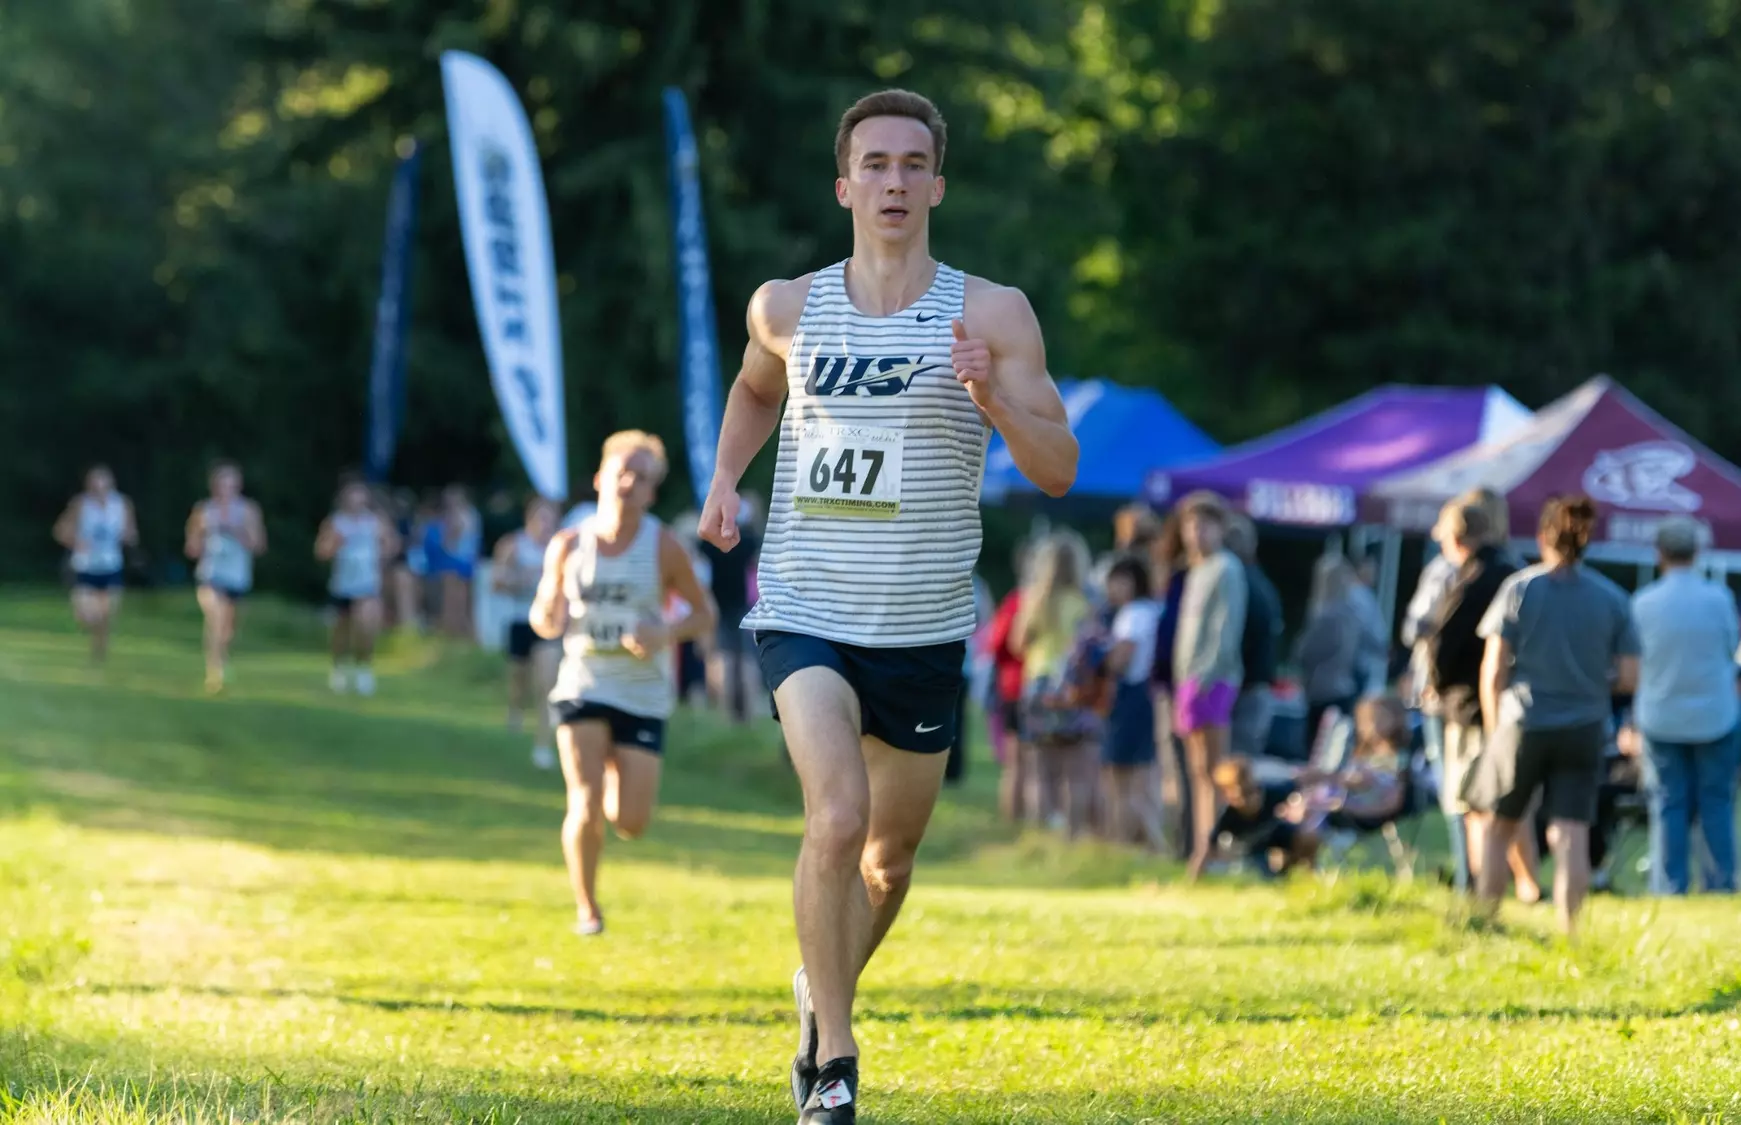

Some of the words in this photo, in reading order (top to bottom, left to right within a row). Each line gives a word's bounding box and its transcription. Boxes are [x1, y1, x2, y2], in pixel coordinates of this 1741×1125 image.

[804, 355, 918, 396] UIS
[809, 447, 885, 496] 647
[796, 496, 897, 509] WWW.TRXCTIMING.COM
